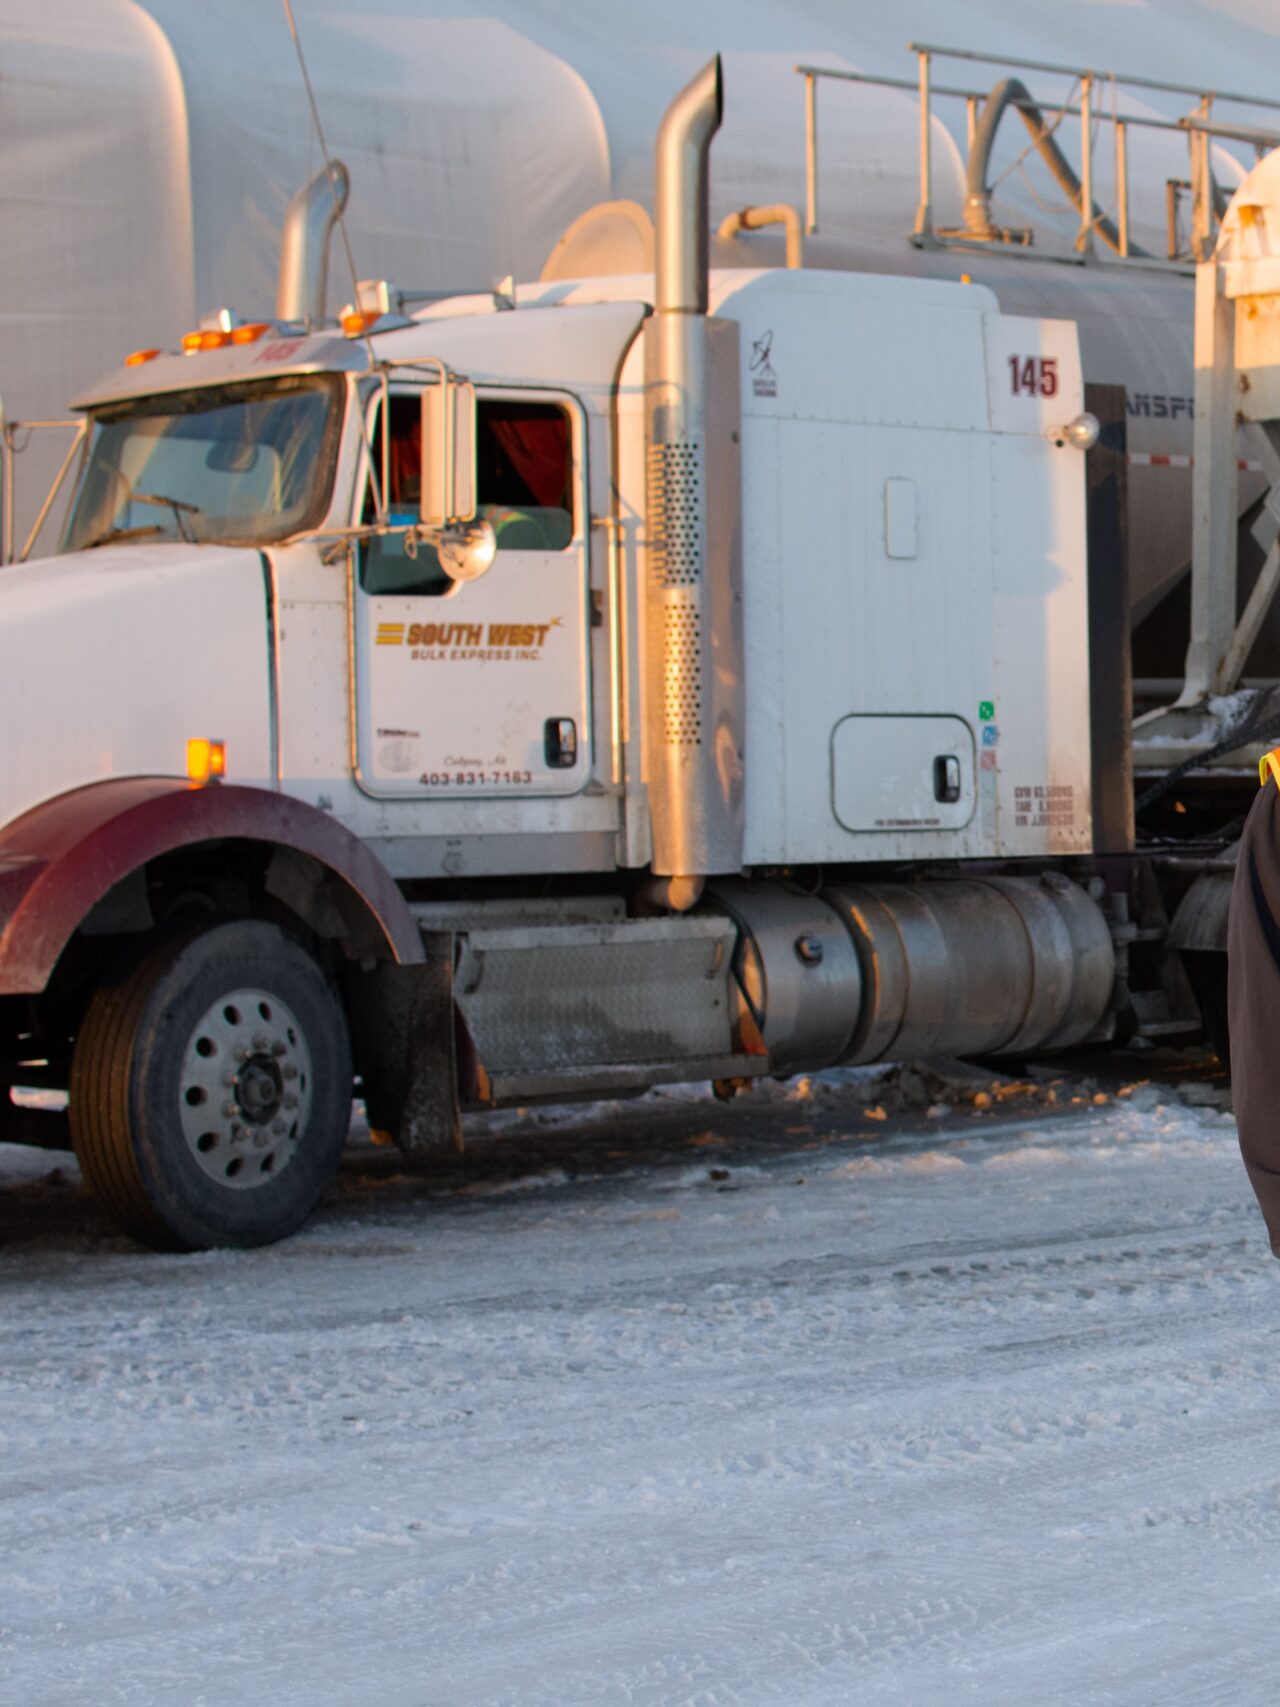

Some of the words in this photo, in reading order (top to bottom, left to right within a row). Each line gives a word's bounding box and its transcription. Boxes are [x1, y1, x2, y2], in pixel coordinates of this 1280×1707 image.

[1007, 355, 1058, 398] 145
[407, 623, 483, 646] SOUTH
[488, 623, 549, 646] WEST
[411, 651, 446, 660] BULK
[451, 650, 511, 661] EXPRESS
[515, 650, 543, 660] INC.
